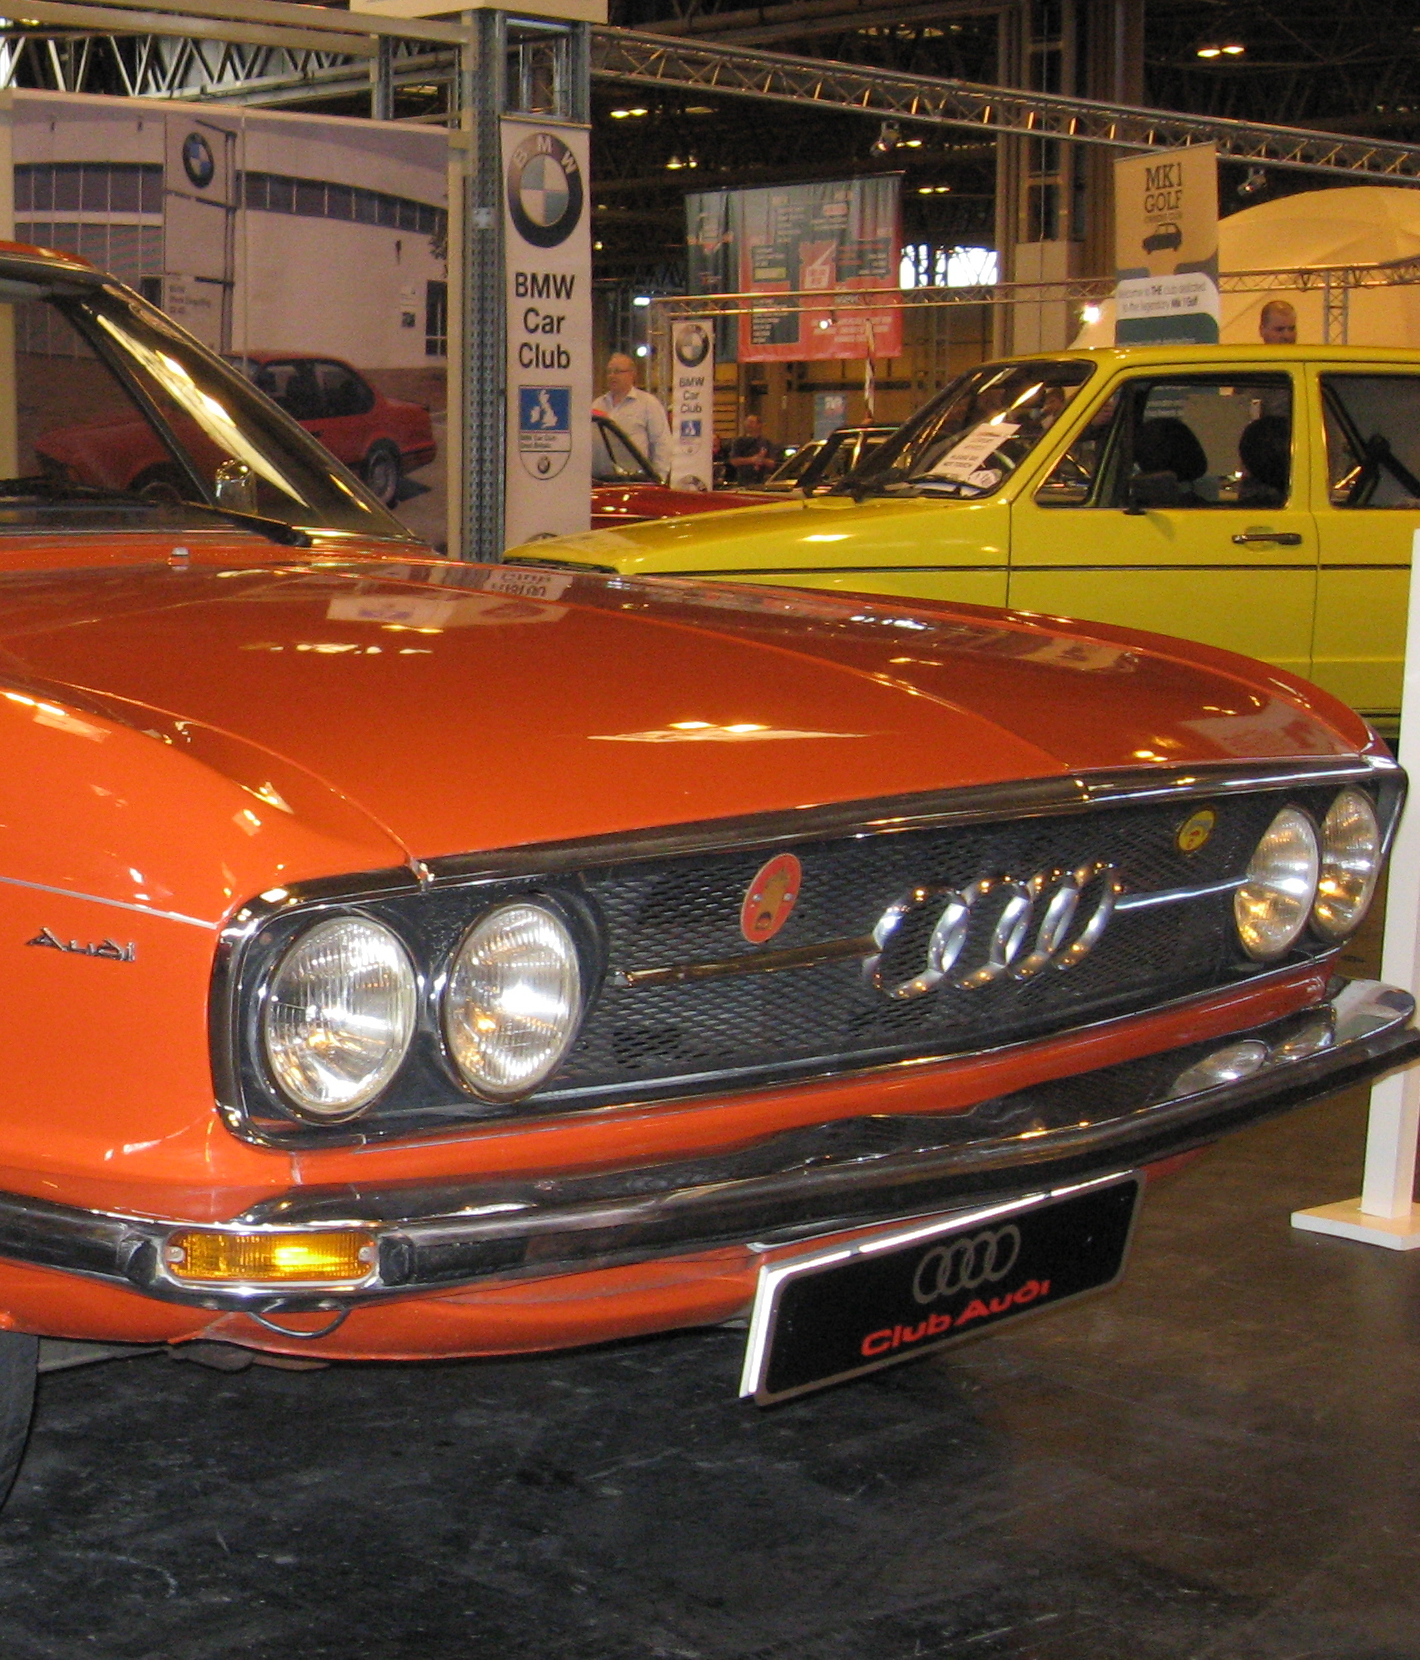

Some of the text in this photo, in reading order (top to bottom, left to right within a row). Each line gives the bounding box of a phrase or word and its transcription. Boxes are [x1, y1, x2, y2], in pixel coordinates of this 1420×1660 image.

[1144, 189, 1182, 213] GOLF
[515, 272, 575, 300] BMW
[523, 307, 566, 334] Car
[518, 342, 571, 369] Club
[679, 376, 705, 387] BMW
[680, 404, 702, 413] Club
[683, 390, 700, 401] Car
[25, 926, 136, 963] Audi
[860, 1279, 1051, 1357] Club Audi
